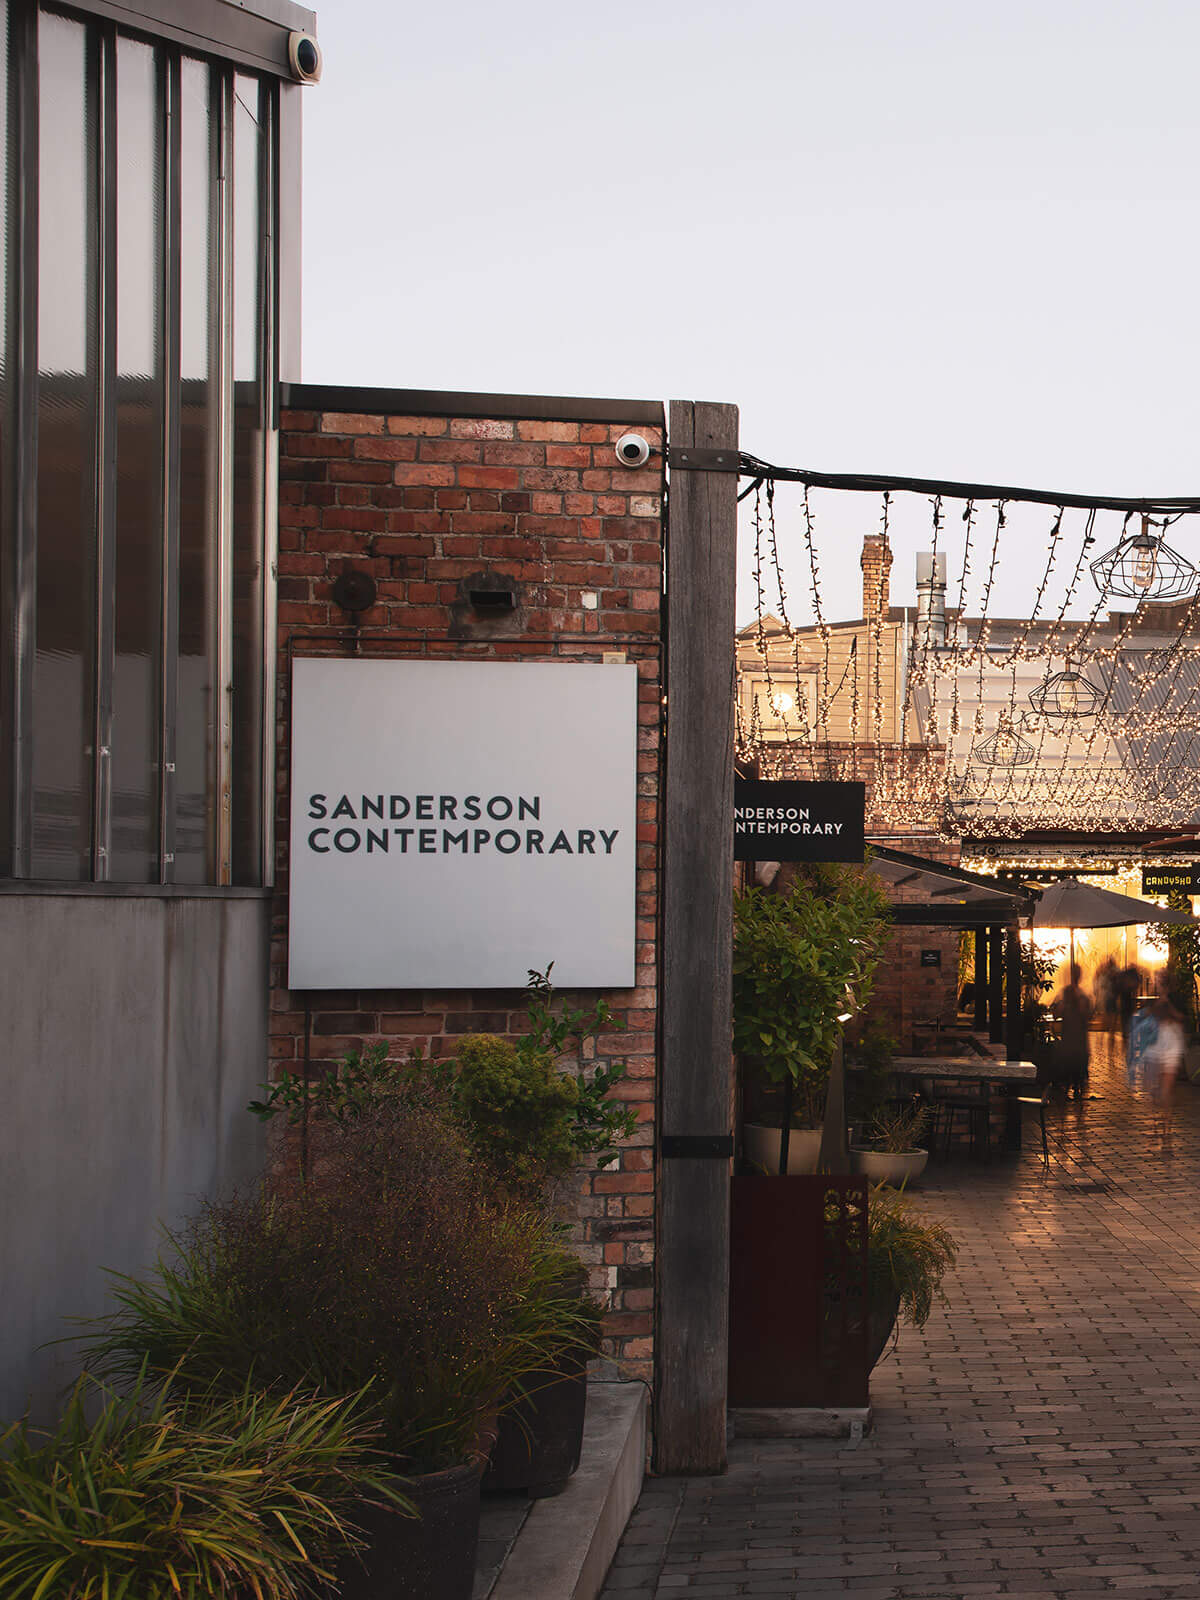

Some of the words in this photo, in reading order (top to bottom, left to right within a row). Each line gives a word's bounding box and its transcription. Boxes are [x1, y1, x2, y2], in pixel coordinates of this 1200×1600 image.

[307, 794, 540, 821] SANDERSON
[734, 807, 810, 820] NDERSON
[735, 822, 843, 835] NTEMPORARY
[307, 827, 620, 854] CONTEMPORARY
[1145, 875, 1192, 886] CANDYSHO
